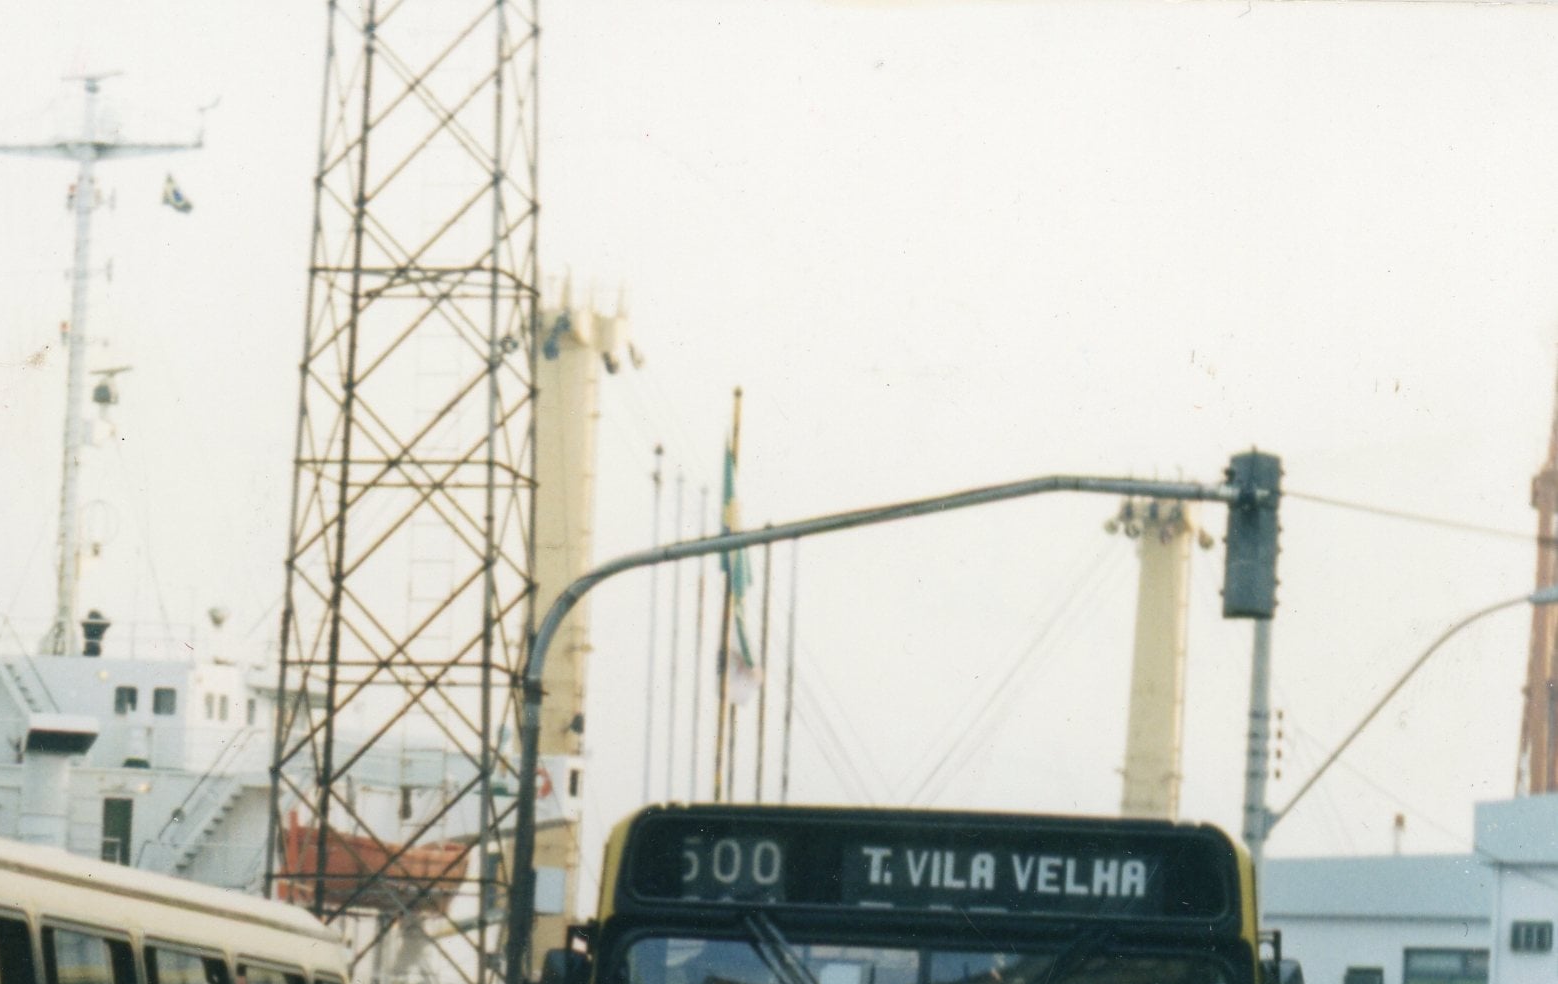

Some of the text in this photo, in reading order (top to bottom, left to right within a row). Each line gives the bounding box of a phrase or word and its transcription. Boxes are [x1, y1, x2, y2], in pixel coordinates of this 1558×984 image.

[862, 847, 1147, 897] T. VILA VELHA
